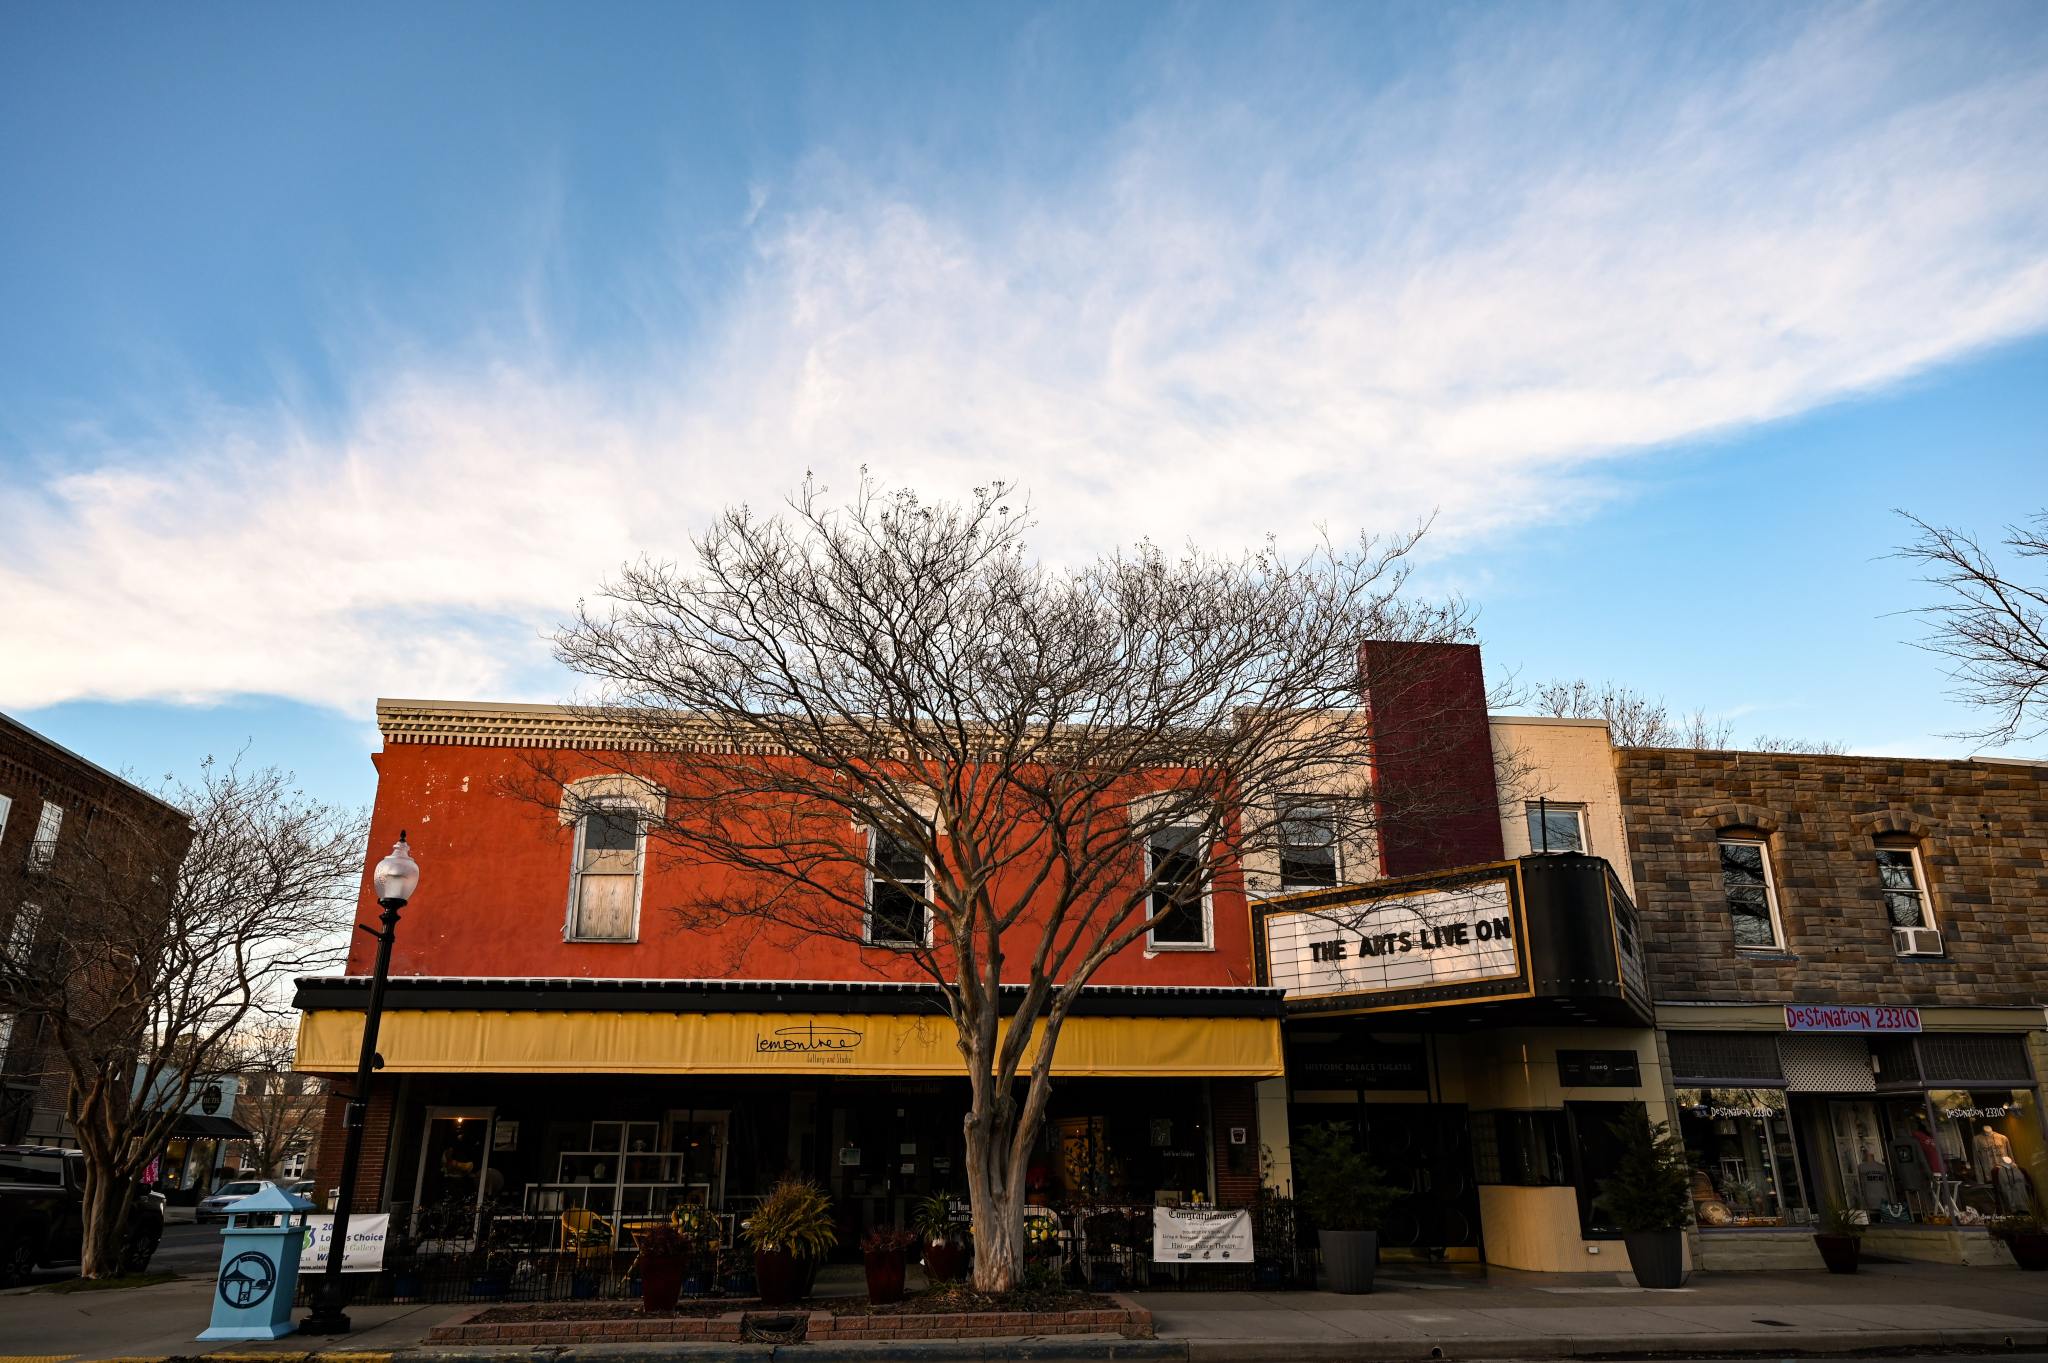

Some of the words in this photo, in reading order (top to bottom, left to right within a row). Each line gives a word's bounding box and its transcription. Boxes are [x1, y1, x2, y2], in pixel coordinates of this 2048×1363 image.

[1309, 940, 1347, 962] THE
[1359, 932, 1412, 957] ARTS
[1419, 923, 1470, 950] LIVE
[1475, 917, 1511, 942] ON
[1876, 1008, 1920, 1028] 23310
[1985, 1108, 2006, 1118] 23310
[1168, 1208, 1238, 1221] Congratulations
[353, 1233, 384, 1242] Choice
[349, 1244, 376, 1252] Gallery
